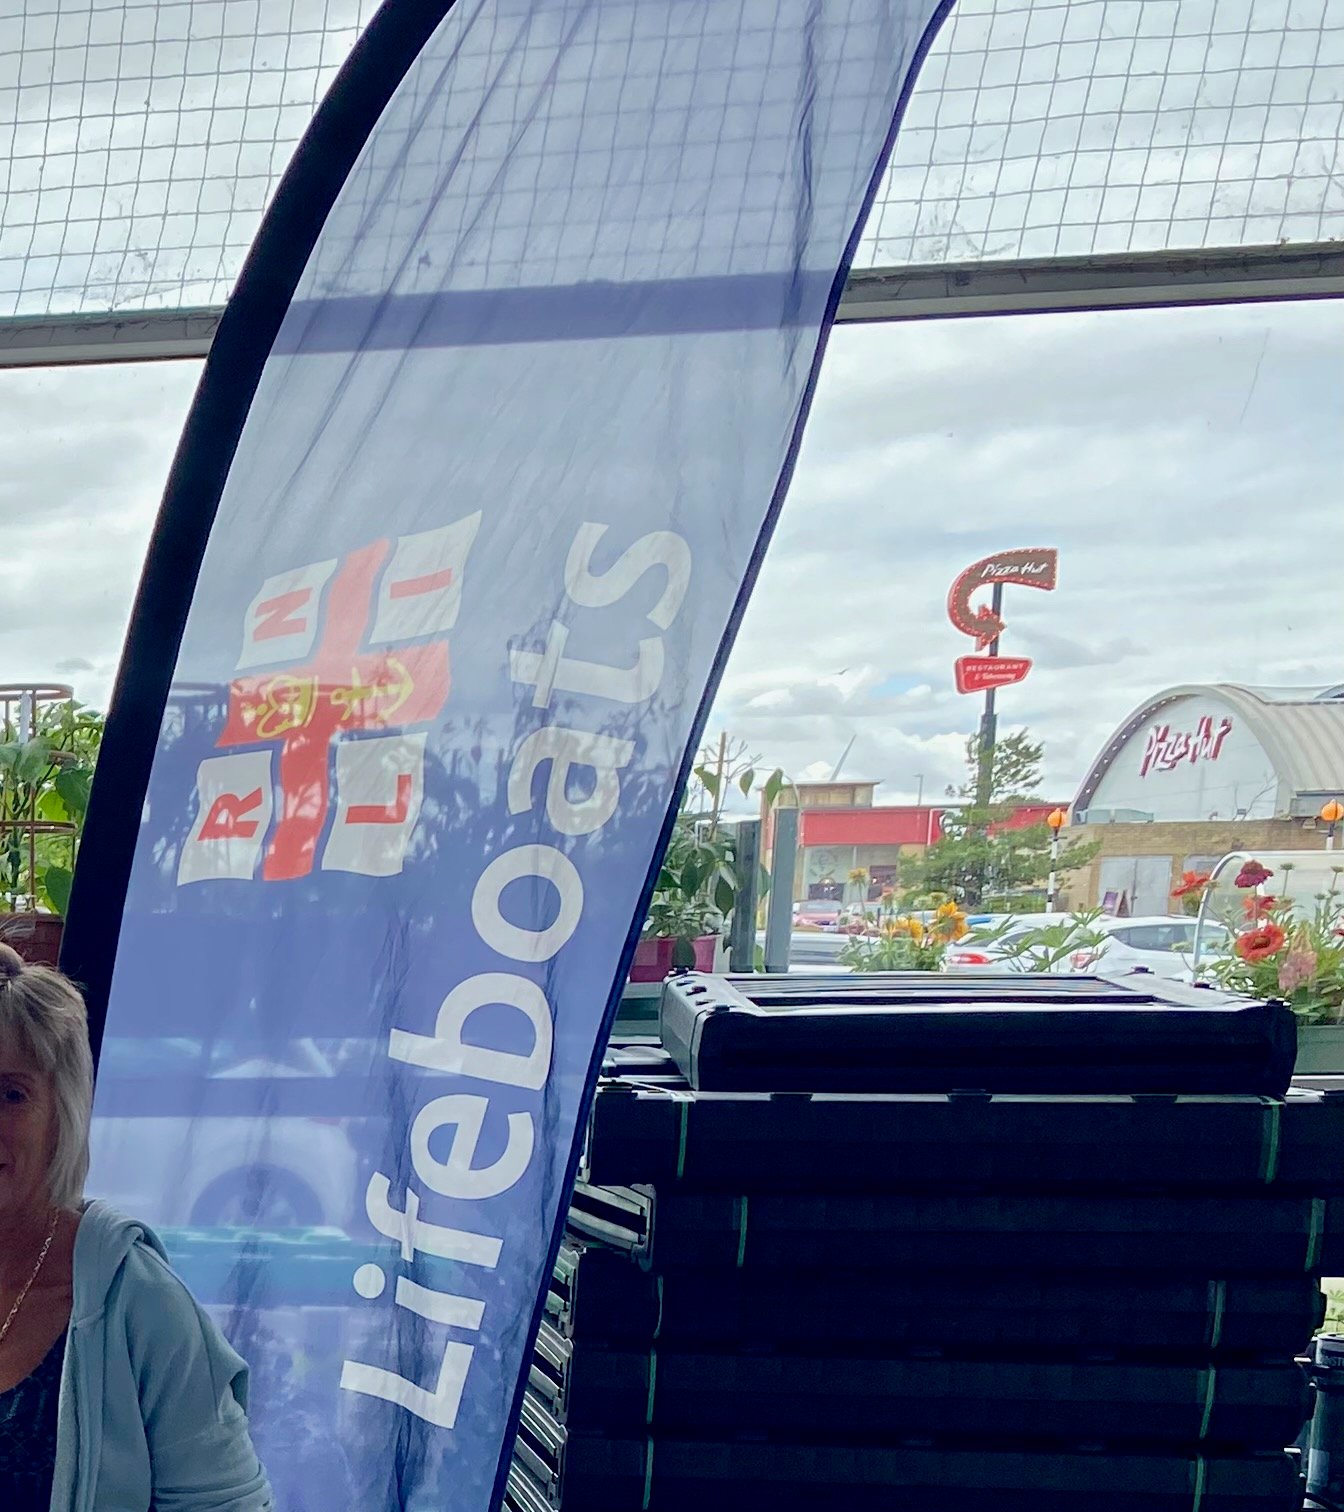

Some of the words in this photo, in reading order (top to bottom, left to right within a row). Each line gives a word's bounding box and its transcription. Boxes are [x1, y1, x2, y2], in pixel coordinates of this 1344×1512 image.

[981, 563, 1019, 578] Pizza
[1020, 561, 1049, 575] Hut
[1139, 724, 1192, 778] Pizza
[1190, 714, 1233, 763] Hut
[340, 521, 693, 1429] Lifeboats
